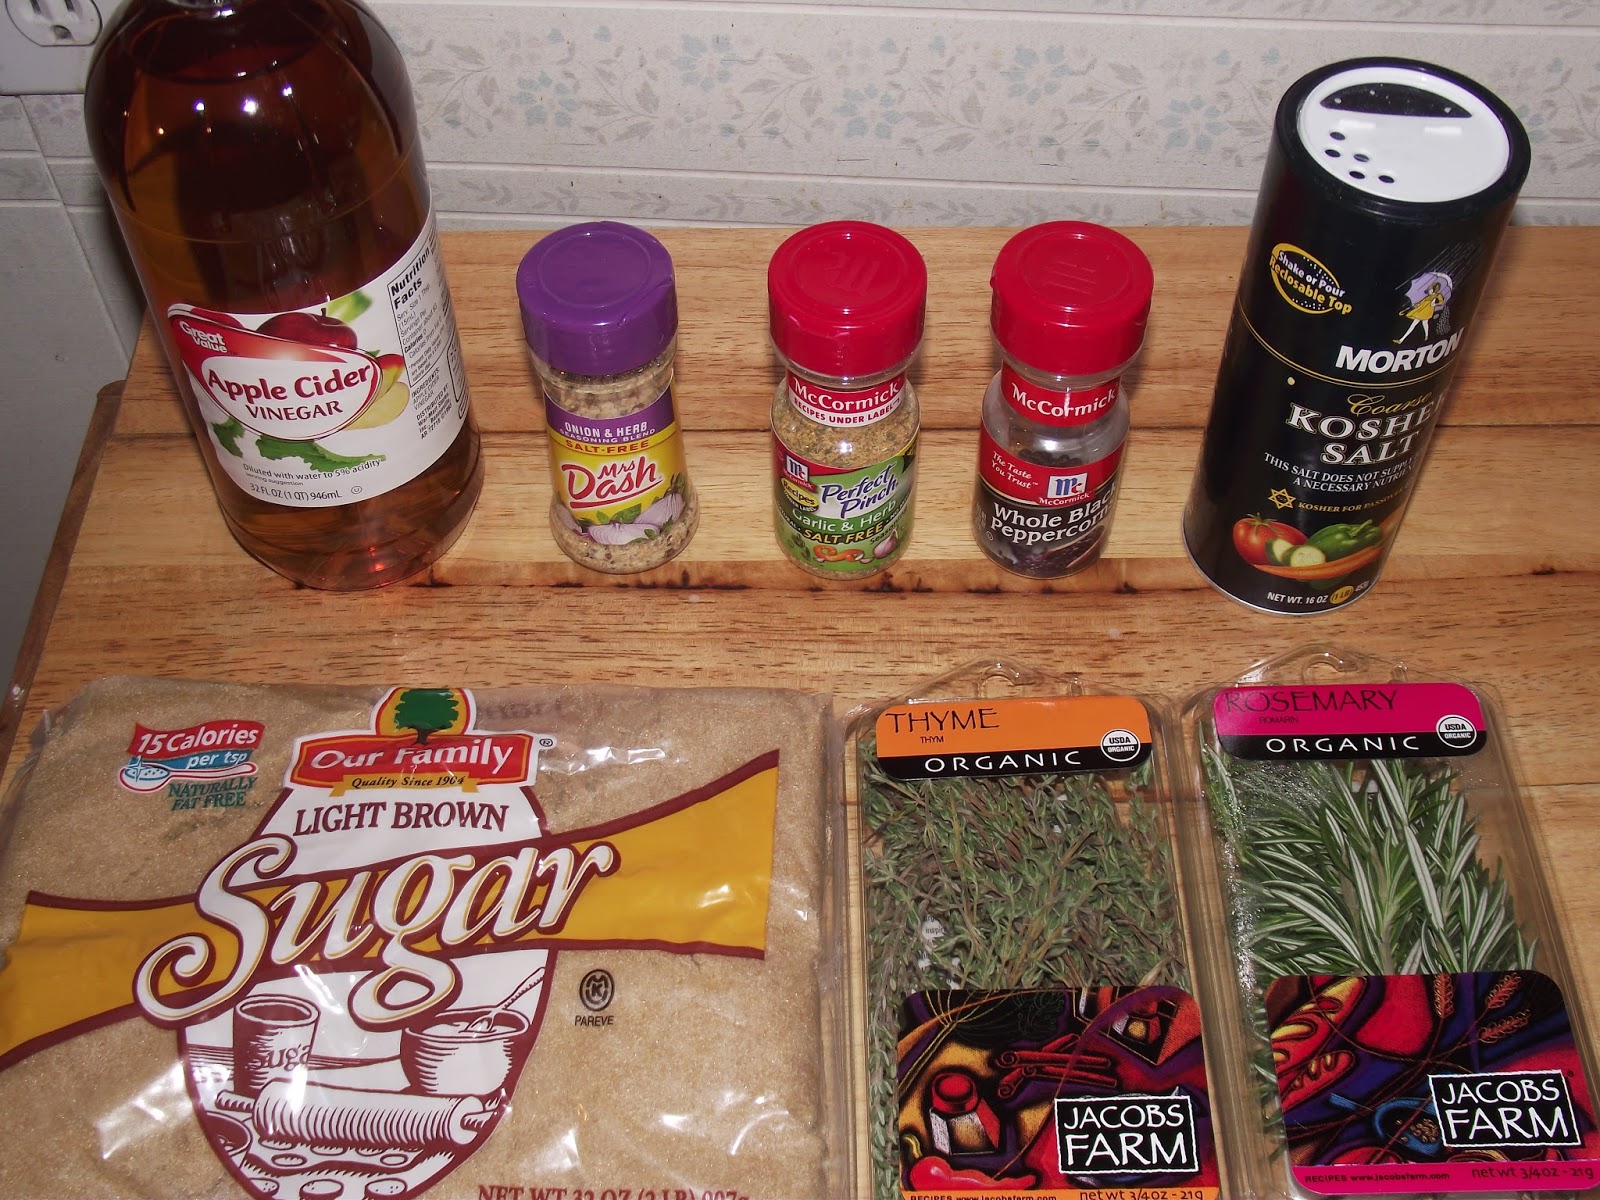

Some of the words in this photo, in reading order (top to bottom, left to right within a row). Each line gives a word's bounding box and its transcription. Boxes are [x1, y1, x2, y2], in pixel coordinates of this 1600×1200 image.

[391, 246, 430, 297] Nutrition
[1278, 251, 1305, 278] Shake
[1306, 274, 1317, 286] or
[1319, 279, 1346, 298] Pour
[393, 277, 423, 311] Facts
[1269, 254, 1326, 304] Reclosable
[1328, 295, 1353, 315] Top
[178, 320, 226, 346] Great
[192, 336, 228, 354] Value
[405, 334, 424, 353] Calories
[1335, 327, 1465, 374] MORTON
[208, 368, 288, 404] Apple
[294, 364, 371, 398] Cider
[793, 376, 899, 411] McCormick
[245, 400, 343, 421] VINEGAR
[416, 388, 444, 421] DISTRIBUTED
[794, 397, 826, 421] RECIPES
[829, 415, 865, 424] UNDER
[867, 404, 894, 421] LABEL
[1011, 382, 1117, 418] McCormick
[564, 421, 600, 438] ONION
[604, 428, 613, 438] &
[616, 421, 648, 437] HERB
[1285, 398, 1440, 441] KOSHE
[559, 428, 618, 443] SEASONING
[622, 428, 655, 442] BLEND
[1320, 431, 1419, 466] SALT
[243, 463, 272, 477] Diluted
[273, 470, 294, 480] with
[295, 473, 321, 481] water
[335, 467, 350, 477] 5%
[352, 459, 381, 474] acidity
[561, 456, 657, 500] Dash
[991, 460, 1005, 477] You
[993, 451, 1006, 466] The
[1007, 462, 1032, 480] Taste
[1264, 452, 1290, 472] THIS
[1291, 465, 1320, 480] SALT
[1321, 472, 1354, 483] DOES
[1355, 470, 1380, 482] NOT
[250, 482, 260, 493] 32
[260, 485, 271, 496] FL
[271, 488, 283, 499] OZ
[294, 491, 310, 502] QT)
[310, 490, 343, 500] 946mL
[783, 479, 815, 505] Recipes
[821, 461, 897, 504] Perfect
[1292, 477, 1301, 486] A
[1303, 480, 1372, 493] NECESSARY
[840, 474, 899, 519] Pinch
[1038, 492, 1090, 506] McCormick
[1298, 501, 1340, 513] KOSHER
[1341, 504, 1362, 513] FOR
[791, 508, 836, 532] Garlic
[840, 521, 854, 532] &
[860, 500, 896, 528] Herb
[993, 502, 1063, 528] Whole
[803, 528, 841, 544] SALT
[845, 521, 885, 544] FREE
[1266, 591, 1286, 602] NET
[1287, 596, 1303, 605] WT.
[1305, 597, 1315, 605] 16
[1316, 595, 1329, 604] OZ
[1224, 689, 1400, 713] ROSEMARY
[885, 707, 1000, 734] THYME
[1258, 716, 1299, 724] ROMARIN
[1444, 723, 1467, 732] USDA
[138, 733, 168, 755] 15
[166, 723, 260, 752] Calories
[920, 735, 944, 744] THYM
[1108, 736, 1131, 745] USDA
[1265, 736, 1421, 753] ORGANIC
[1443, 731, 1472, 740] ORGANIC
[186, 753, 220, 769] per
[223, 750, 248, 766] tsp
[310, 749, 384, 769] Our
[393, 738, 514, 775] Family
[1107, 744, 1135, 753] ORGANIC
[924, 750, 1082, 773] ORGANIC
[168, 776, 259, 798] NATURALLY
[351, 776, 398, 789] Quality
[400, 776, 434, 787] Since
[435, 774, 466, 786] 1904
[171, 797, 200, 812] FAT
[203, 791, 248, 808] FREE
[292, 801, 387, 837] LIGHT
[390, 800, 511, 832] BROWN
[135, 837, 615, 1023] Sugar
[574, 1014, 615, 1027] PAREVE
[1441, 1078, 1561, 1105] JACOBS
[1063, 1103, 1185, 1130] JACOBS
[1444, 1106, 1569, 1140] FARM
[1065, 1131, 1188, 1167] FARM
[1304, 1174, 1348, 1183] RECIPES
[1350, 1172, 1450, 1182] www.jacobsfarm.com
[1471, 1167, 1496, 1178] net
[1496, 1167, 1517, 1177] wt
[1570, 1167, 1595, 1180] 21g
[1080, 1189, 1104, 1200] net
[1105, 1190, 1125, 1200] wt
